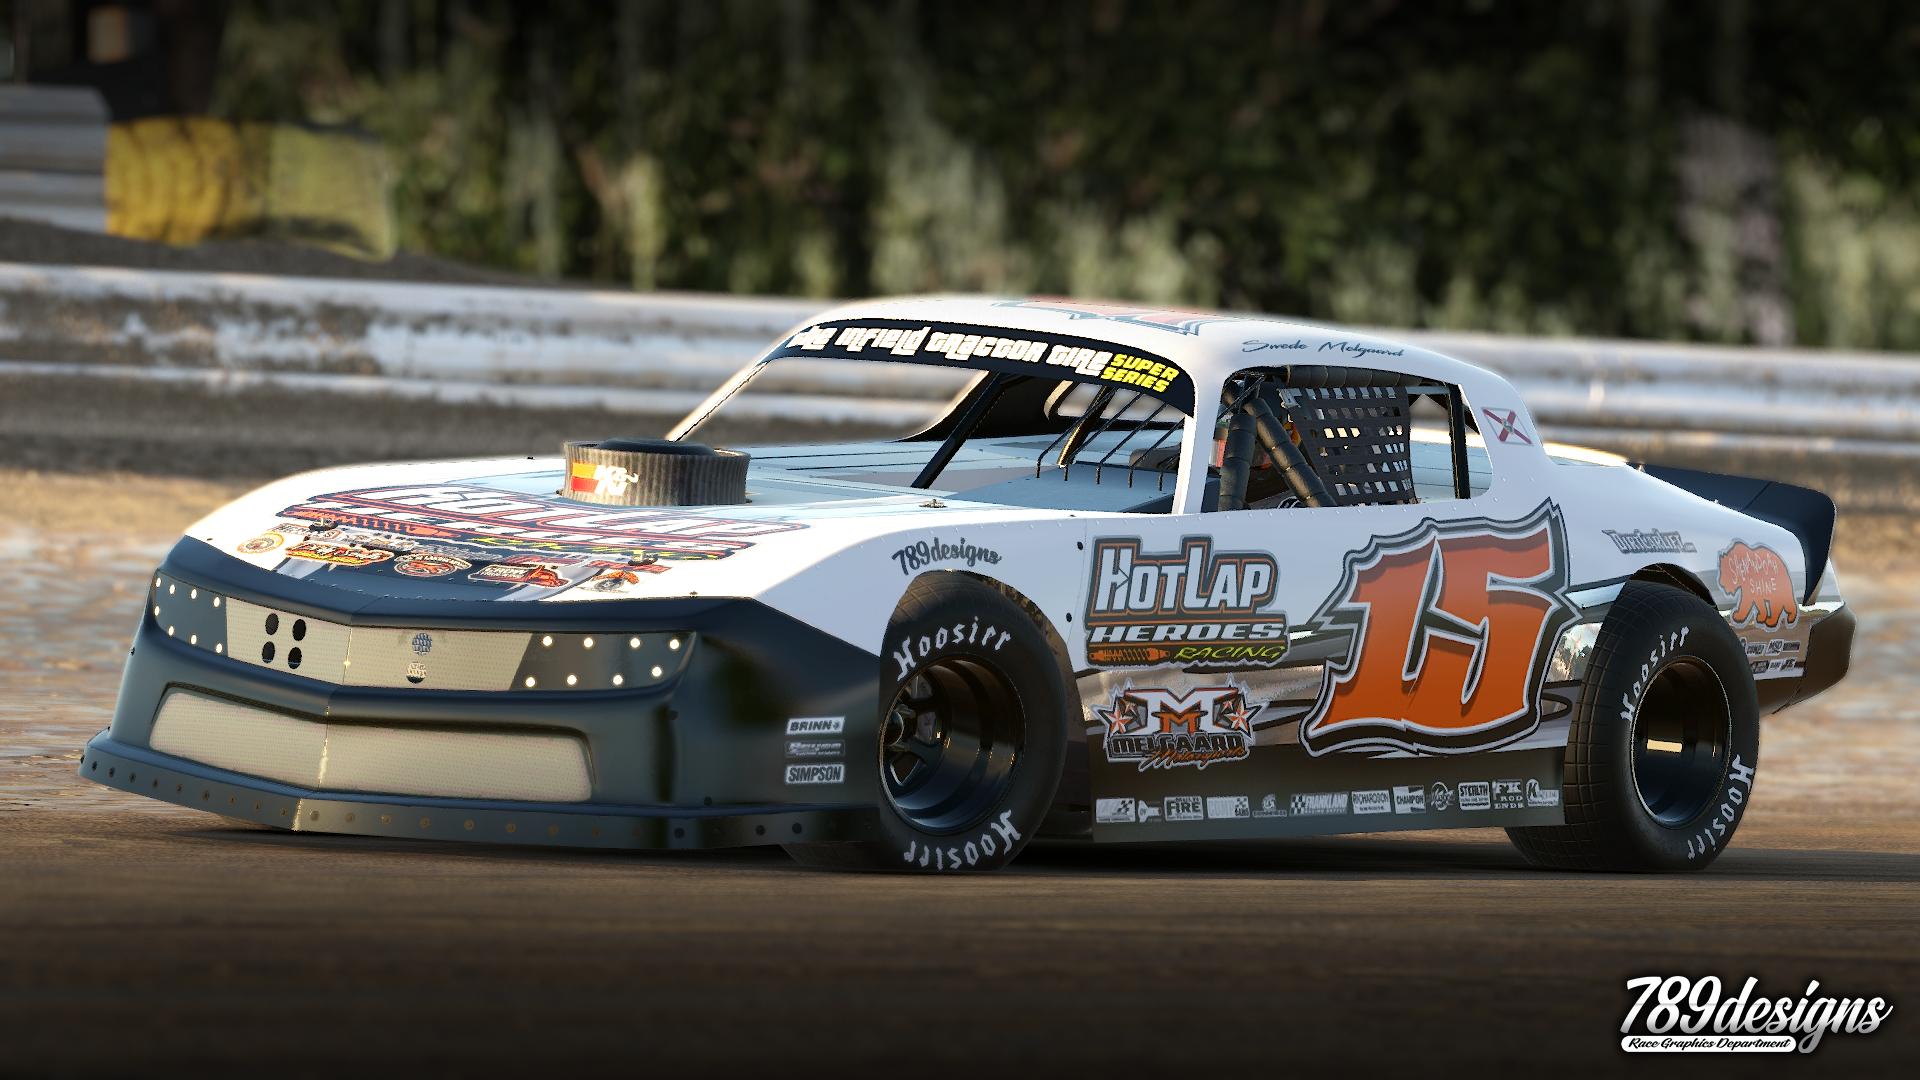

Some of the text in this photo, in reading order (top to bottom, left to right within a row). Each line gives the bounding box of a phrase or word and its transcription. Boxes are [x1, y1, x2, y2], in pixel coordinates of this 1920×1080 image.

[1242, 339, 1308, 353] Swede
[1100, 366, 1170, 393] SERIES
[1111, 353, 1180, 382] SUPER
[891, 536, 1003, 576] 789designs
[1088, 622, 1286, 644] HEROES
[1306, 524, 1562, 736] 15
[892, 616, 1012, 682] Hoosier
[1173, 645, 1287, 660] RACING
[1620, 626, 1690, 724] Hoosier
[790, 720, 832, 731] BRINN
[1110, 735, 1246, 755] MELGAARD
[788, 766, 842, 782] SIMPSON
[1459, 784, 1489, 797] STEALTH
[1167, 800, 1201, 816] FIRE
[1686, 754, 1755, 860] Hoosier
[903, 809, 1022, 871] Hoosier
